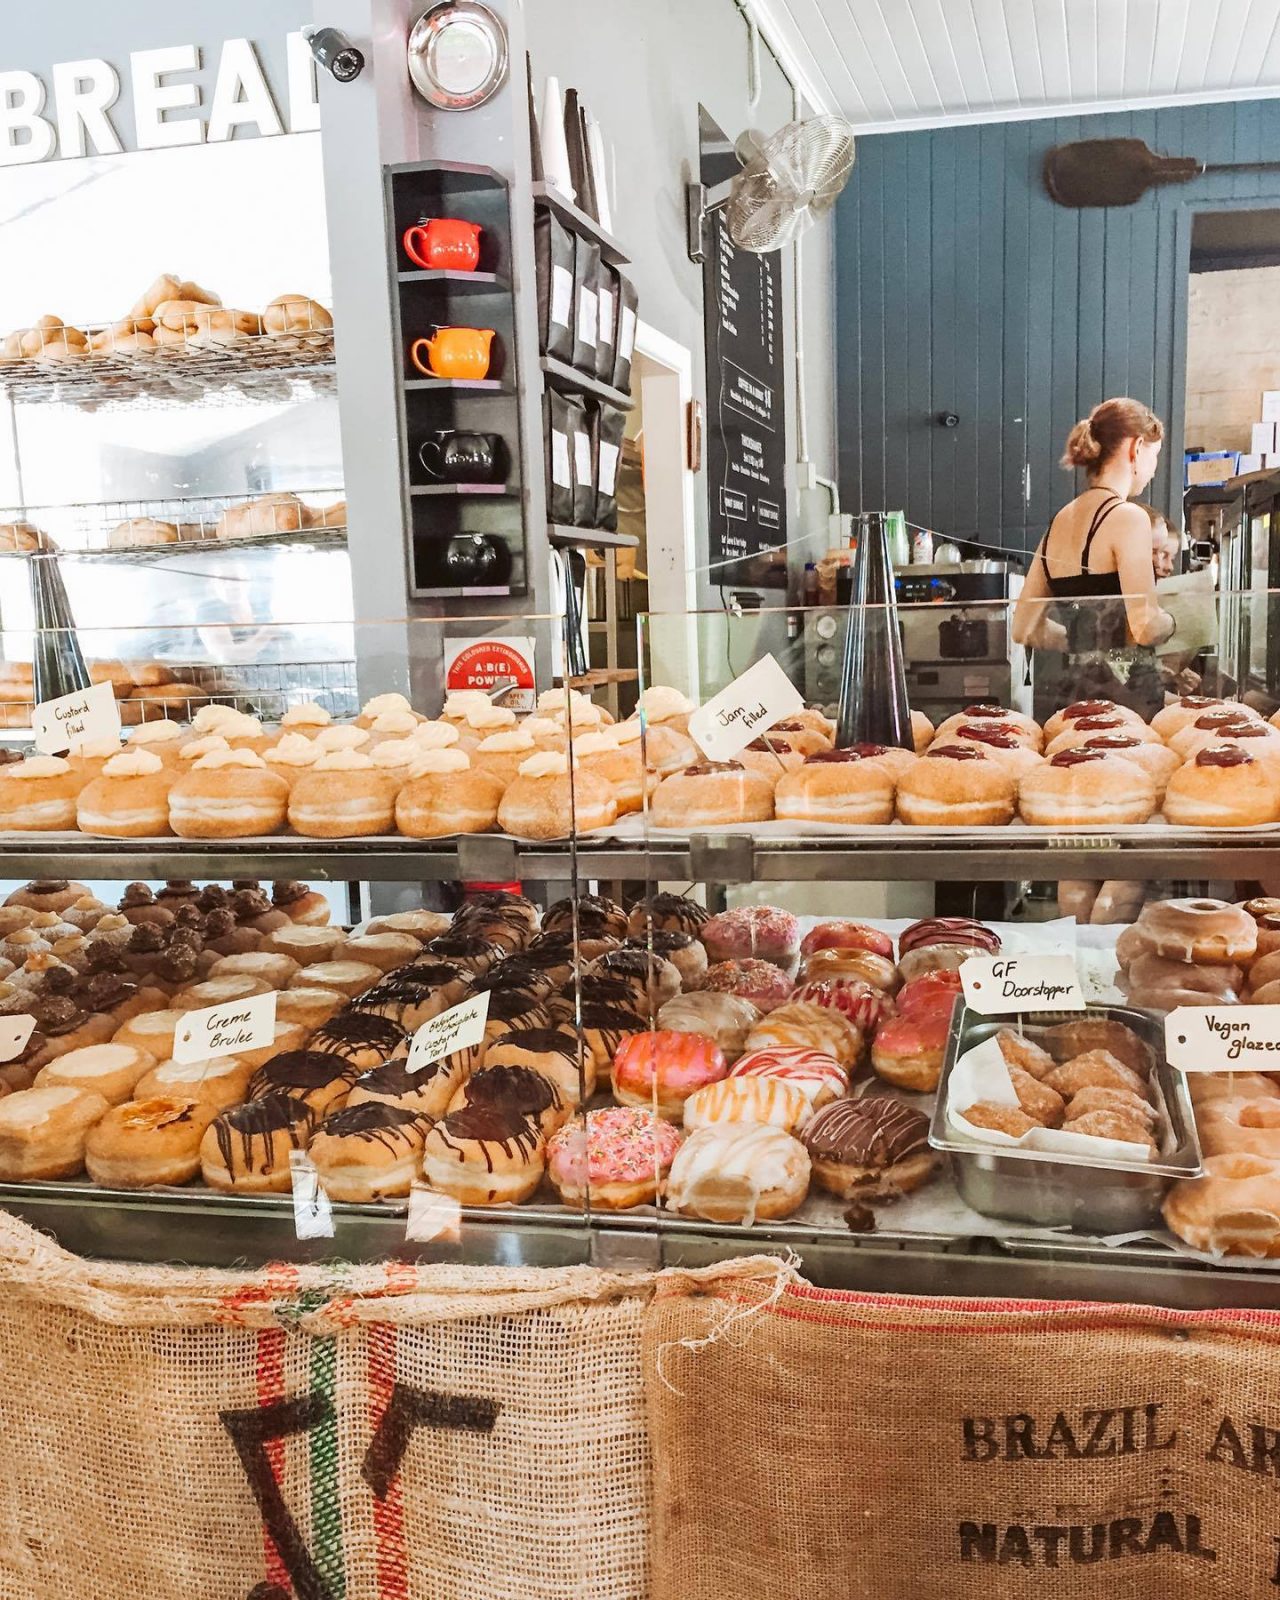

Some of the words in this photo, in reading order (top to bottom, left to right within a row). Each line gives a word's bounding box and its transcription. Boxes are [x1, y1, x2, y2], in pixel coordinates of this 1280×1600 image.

[54, 700, 91, 721] Custard
[716, 706, 746, 727] Jam
[742, 702, 768, 729] filled
[65, 719, 85, 739] filled
[992, 960, 1018, 979] GF
[1002, 980, 1074, 1001] Doorstopper
[206, 1010, 252, 1031] Creme
[1204, 1015, 1250, 1040] Vegan
[209, 1028, 253, 1049] Brulee
[424, 1026, 460, 1051] Custard
[960, 1402, 1178, 1462] BRAZIL
[958, 1510, 1217, 1568] NATURAL
